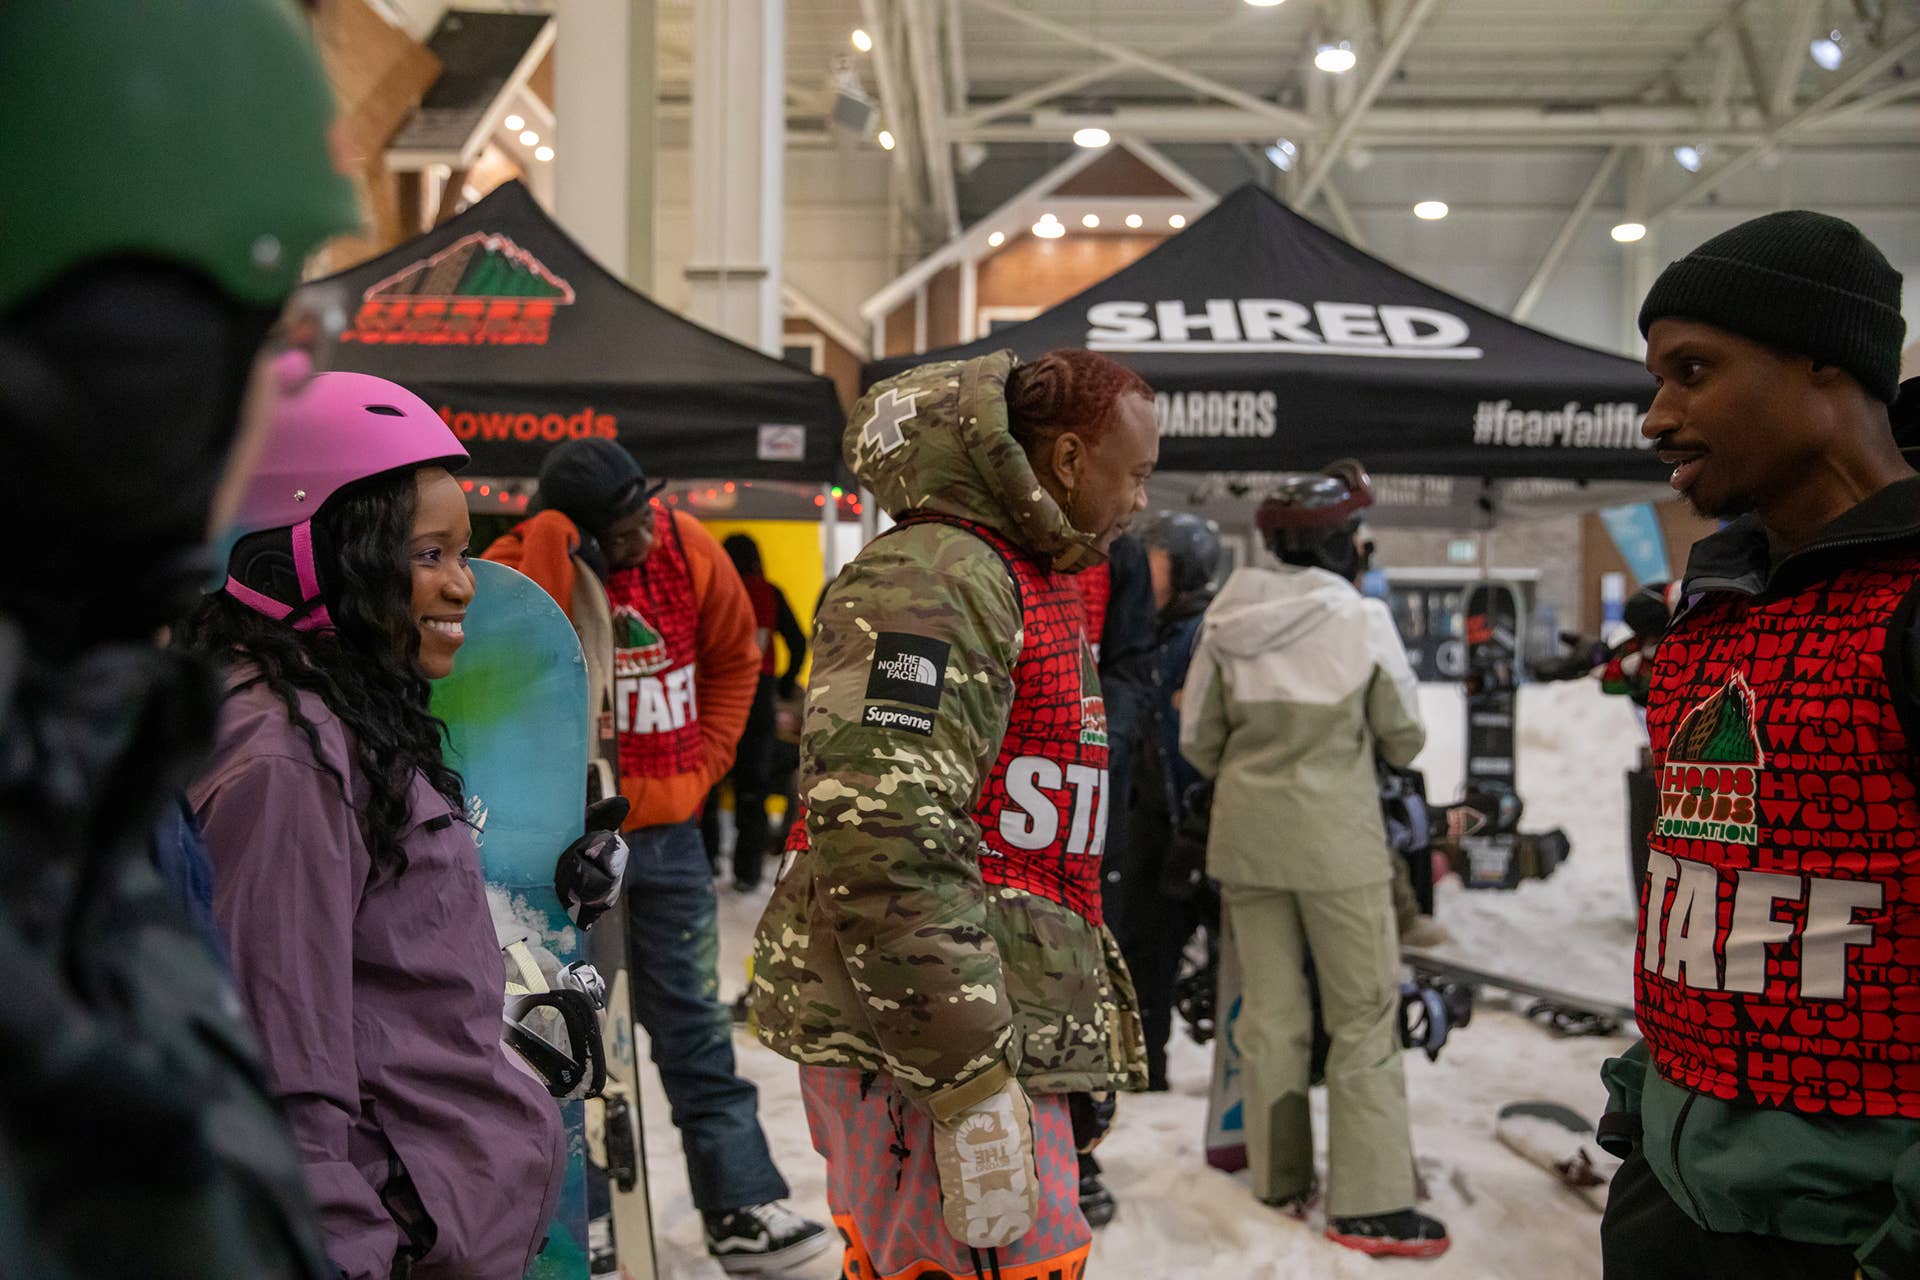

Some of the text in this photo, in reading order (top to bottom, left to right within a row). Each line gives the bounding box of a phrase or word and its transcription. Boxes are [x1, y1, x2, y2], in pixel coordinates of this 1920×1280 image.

[1087, 299, 1471, 348] SHRED
[1155, 391, 1277, 437] OARDERS
[878, 660, 917, 673] NORTH
[897, 653, 920, 664] THE
[887, 669, 916, 681] FACE
[866, 706, 931, 730] Supreme
[1664, 766, 1754, 796] HOODS
[1662, 792, 1754, 824] WOODS
[1656, 817, 1756, 843] FOUNDATION
[1644, 848, 1882, 1001] TAFF
